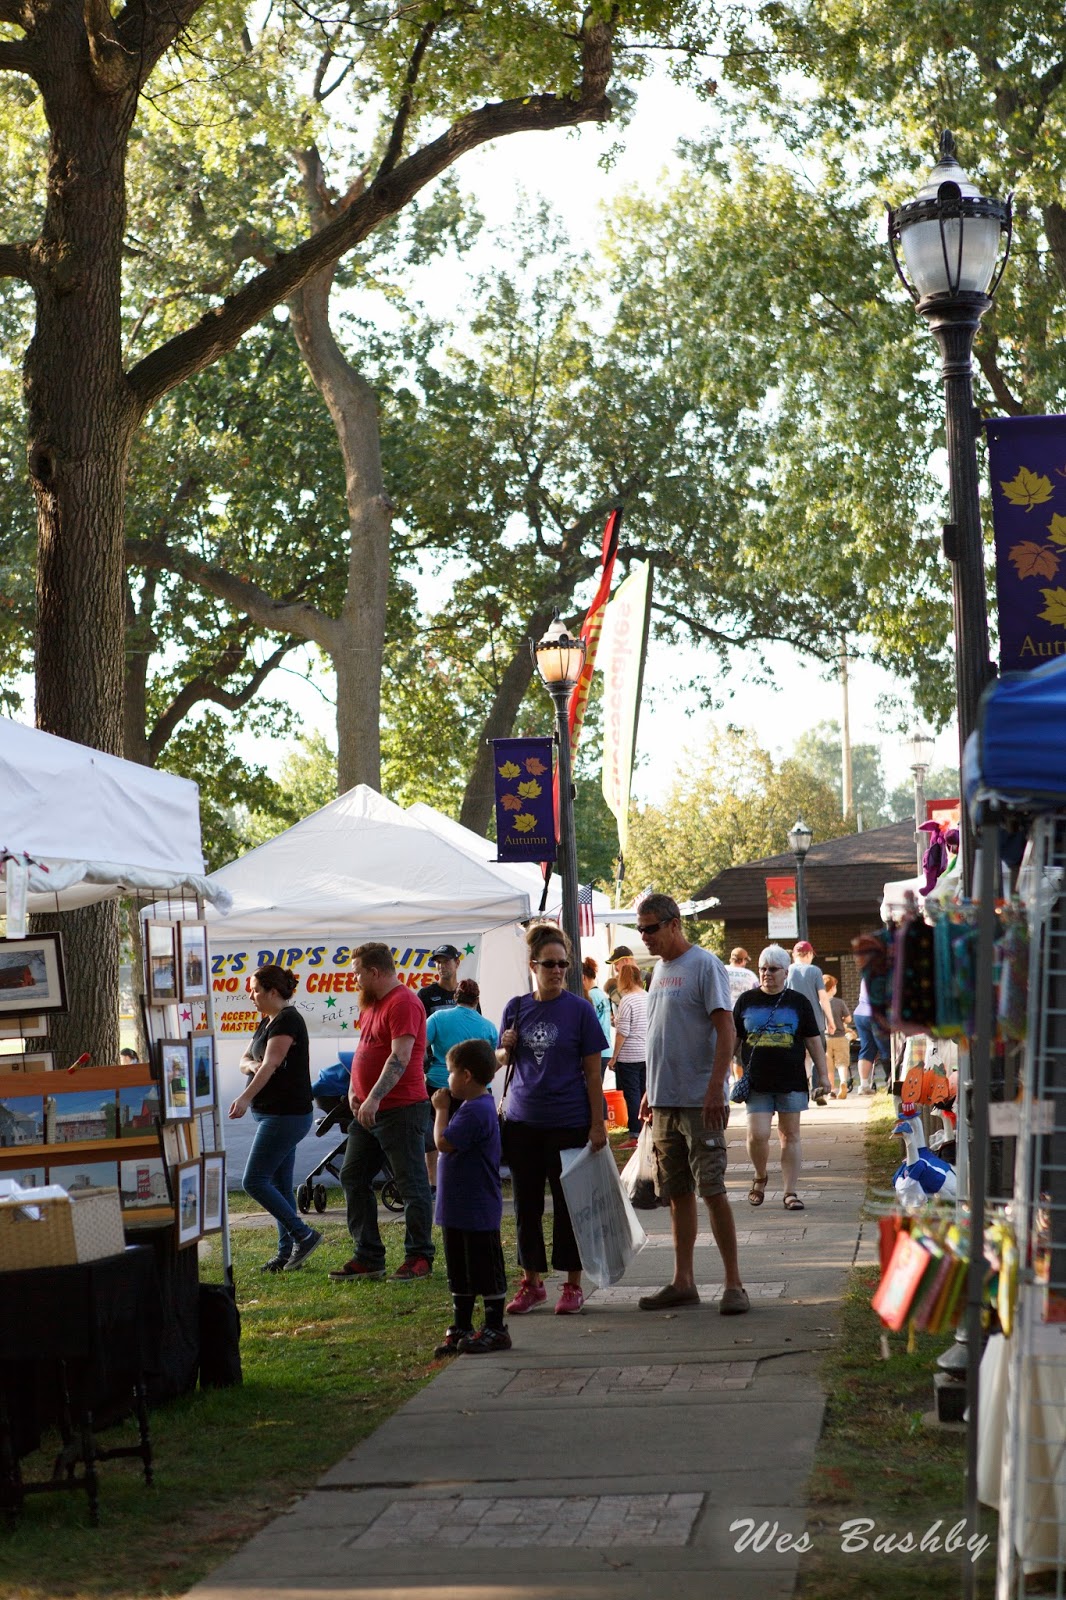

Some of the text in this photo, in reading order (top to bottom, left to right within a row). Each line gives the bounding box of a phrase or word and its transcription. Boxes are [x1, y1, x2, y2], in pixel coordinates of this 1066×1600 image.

[1019, 635, 1066, 656] Aut
[504, 835, 548, 845] Autumn
[257, 947, 328, 970] DIP'S
[332, 946, 352, 968] &
[212, 977, 240, 993] NO
[220, 1011, 259, 1022] ACCEPT
[322, 1008, 344, 1024] Fat
